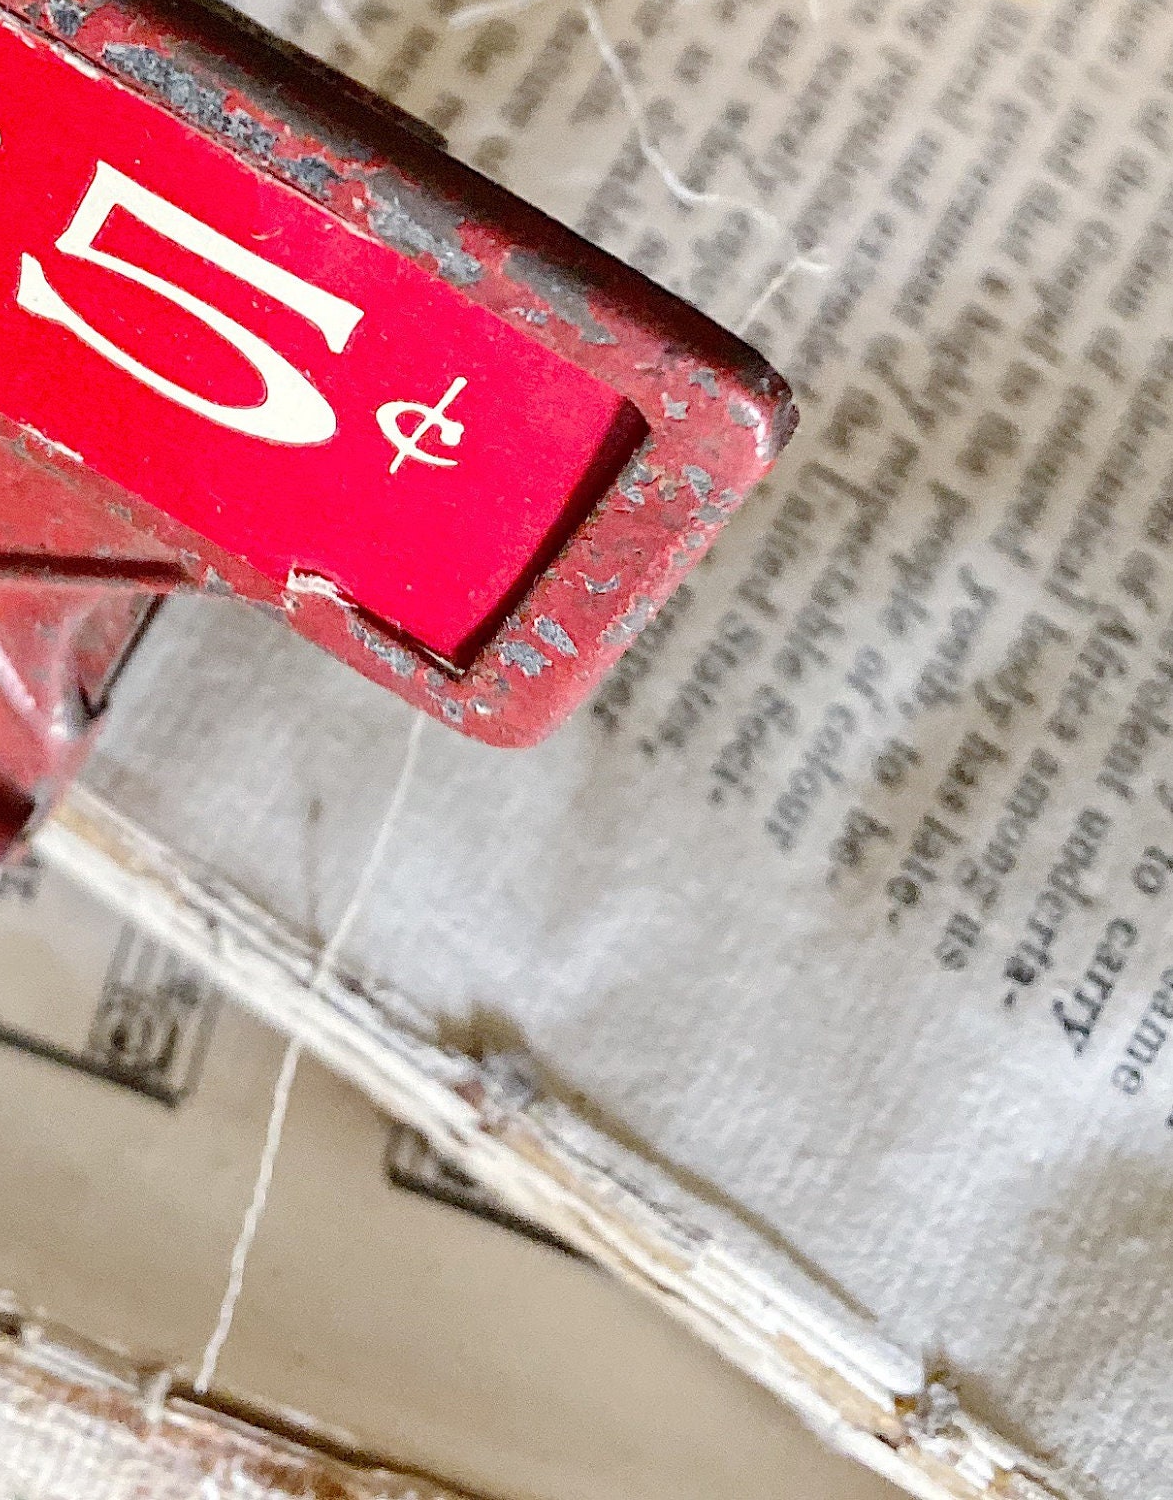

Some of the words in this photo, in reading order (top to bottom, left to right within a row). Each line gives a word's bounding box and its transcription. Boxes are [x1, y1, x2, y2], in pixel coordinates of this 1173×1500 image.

[1044, 604, 1140, 744] Africa
[883, 811, 964, 927] late-
[953, 746, 1062, 908] among
[1001, 805, 1112, 1009] underta-
[1050, 914, 1141, 1053] carry
